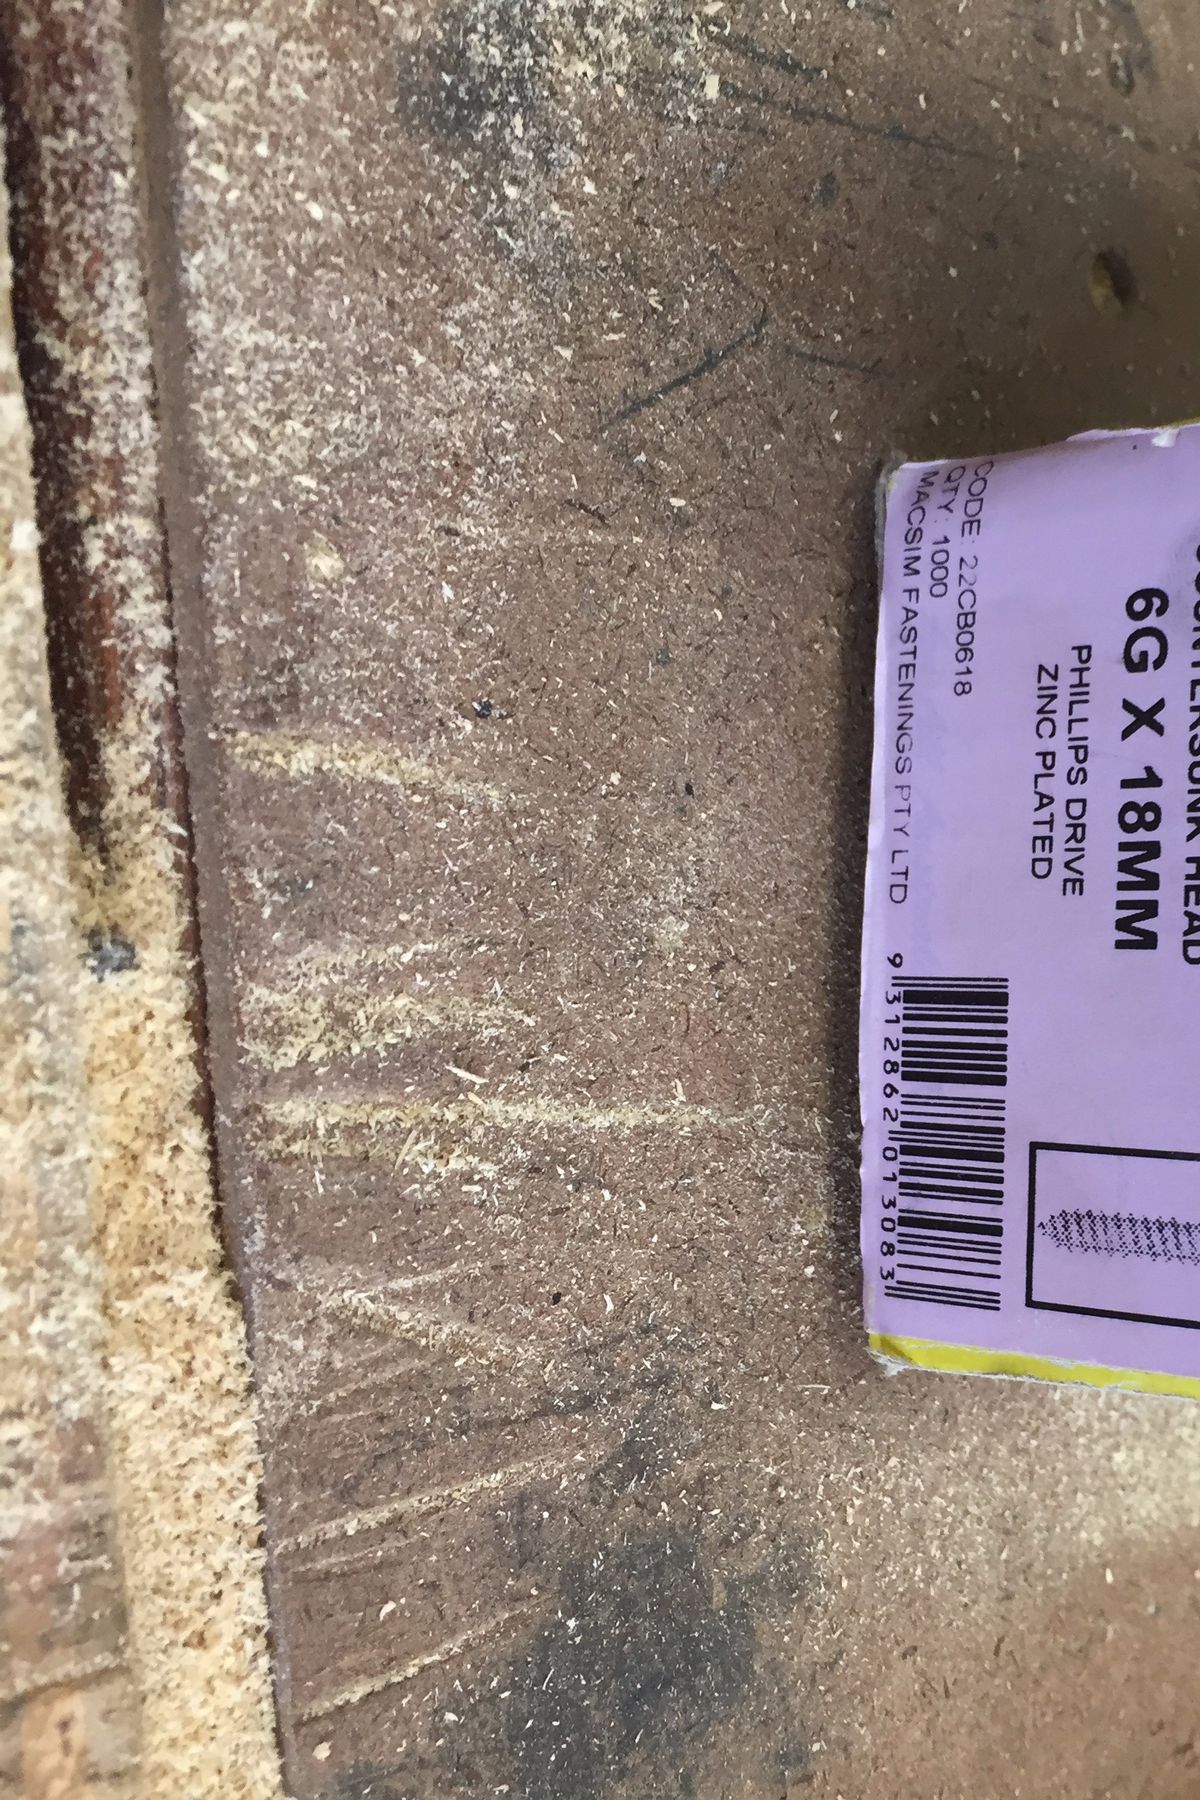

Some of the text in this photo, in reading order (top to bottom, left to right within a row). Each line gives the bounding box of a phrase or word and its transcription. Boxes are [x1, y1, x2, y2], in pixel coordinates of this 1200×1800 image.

[889, 470, 940, 905] MACSIM FASTENINGS PTY LTD
[929, 535, 951, 598] 1000
[953, 460, 994, 697] CODE: 22CB0618
[1031, 663, 1059, 880] ZINC PLATED
[1061, 645, 1092, 897] PHILLIPS DRIVE
[1114, 586, 1170, 951] 6G X 18MM
